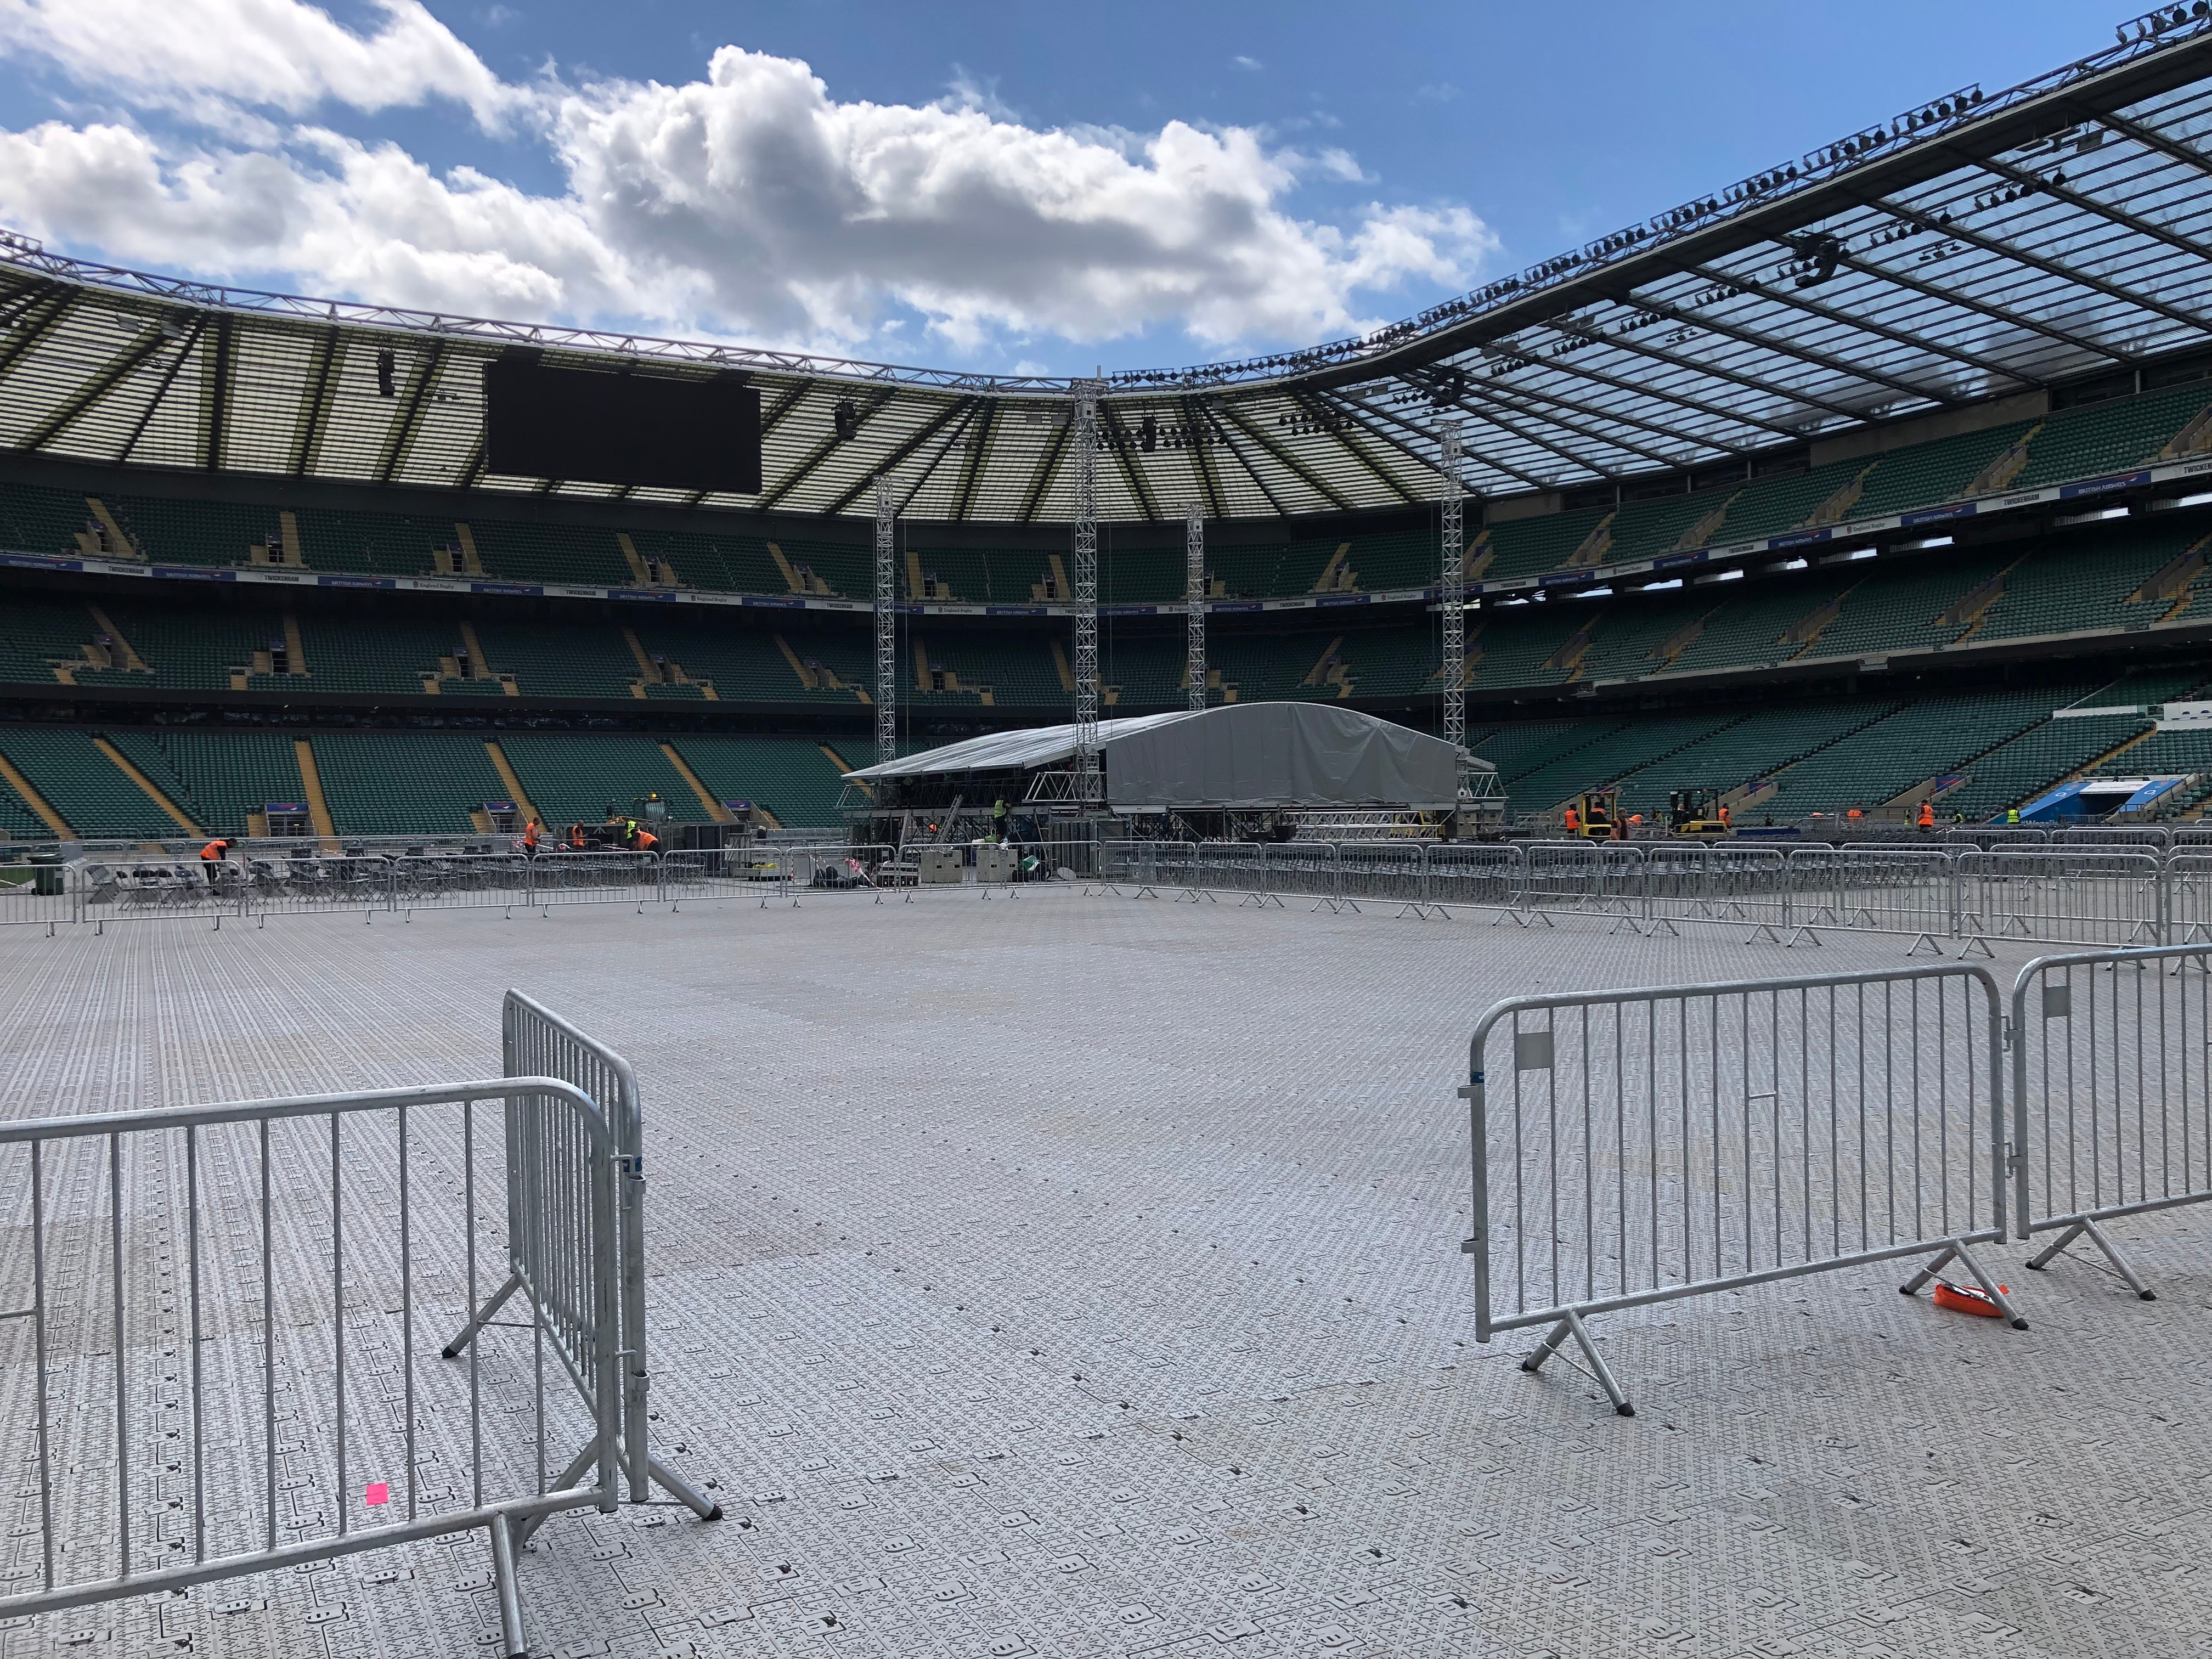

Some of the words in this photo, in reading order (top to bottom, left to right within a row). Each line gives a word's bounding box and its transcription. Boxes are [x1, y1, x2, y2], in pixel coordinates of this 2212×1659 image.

[2078, 486, 2101, 494] BRITISH
[2102, 481, 2126, 490] AIRWAYS
[2004, 494, 2040, 505] TWICKENHAM
